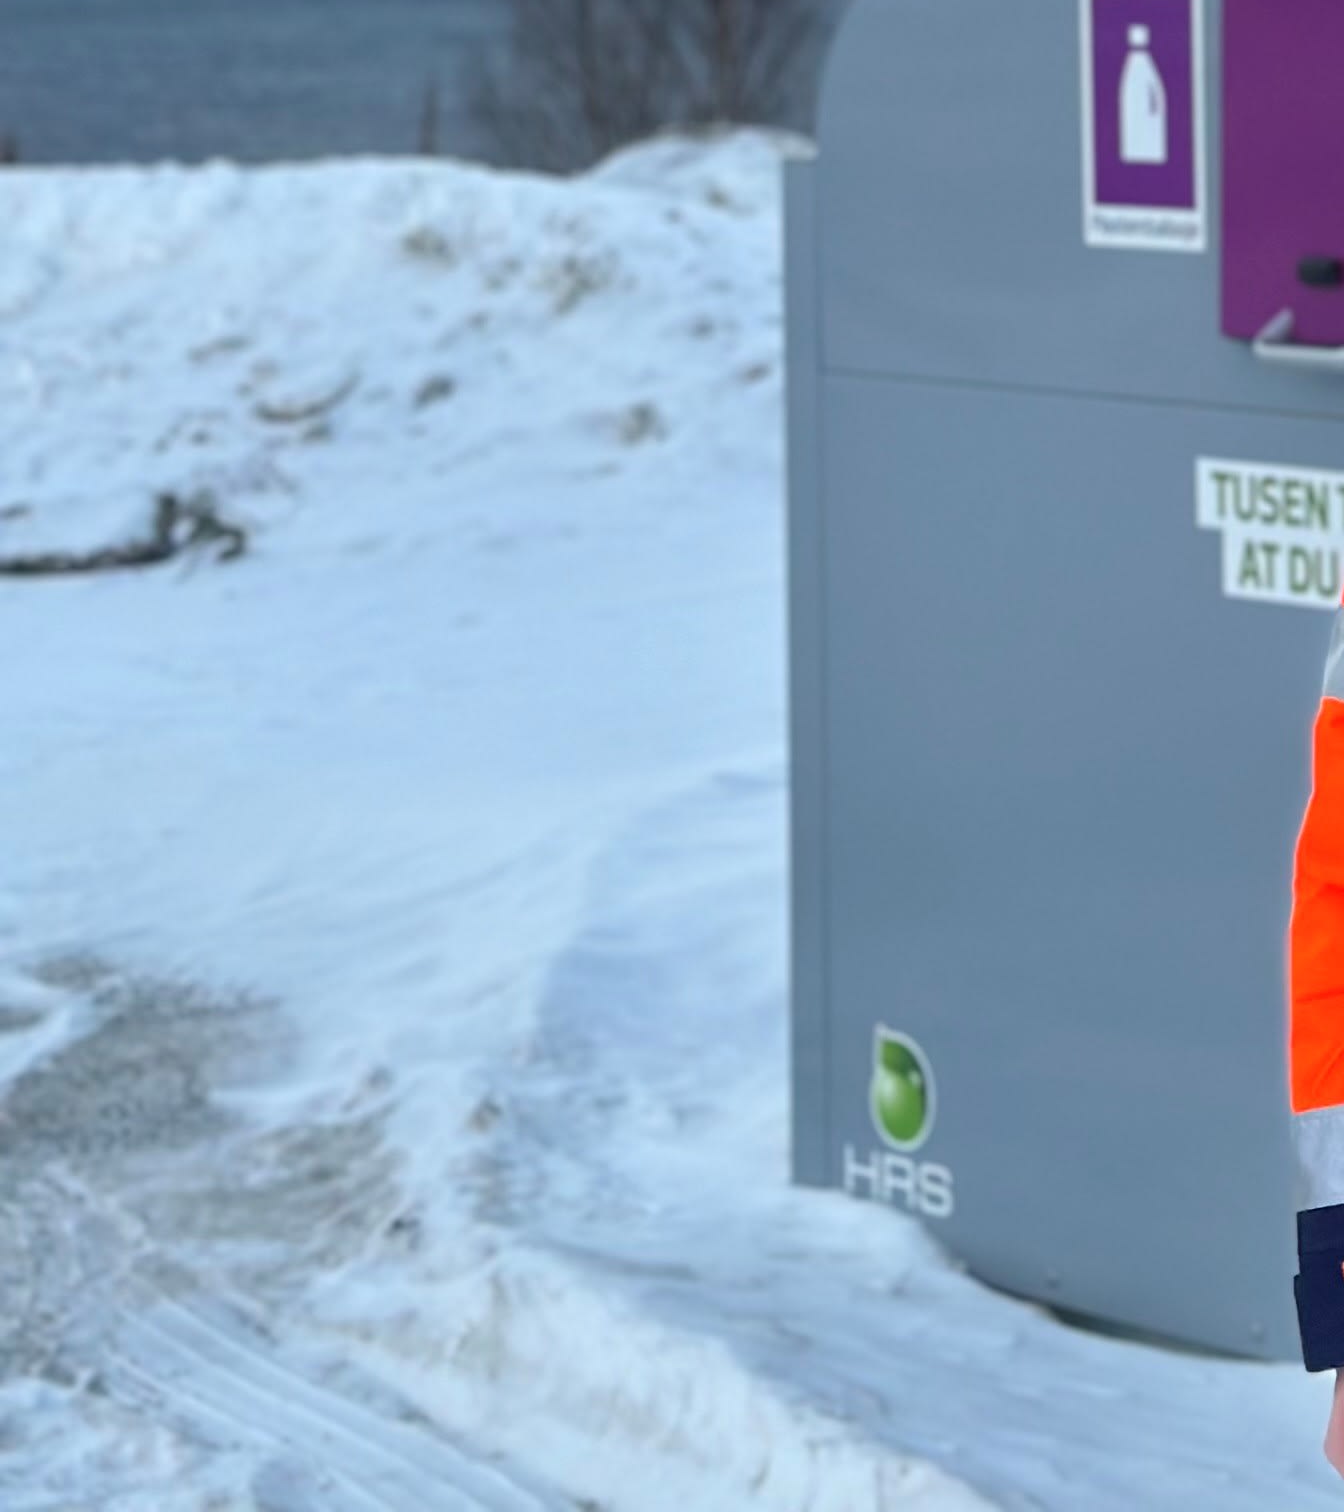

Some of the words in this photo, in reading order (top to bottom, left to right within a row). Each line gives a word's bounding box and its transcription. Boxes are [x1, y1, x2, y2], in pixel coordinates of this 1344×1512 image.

[1210, 470, 1329, 531] TUSEN
[1238, 538, 1280, 590] AT
[1287, 544, 1340, 599] DU
[843, 1143, 955, 1220] HRS
